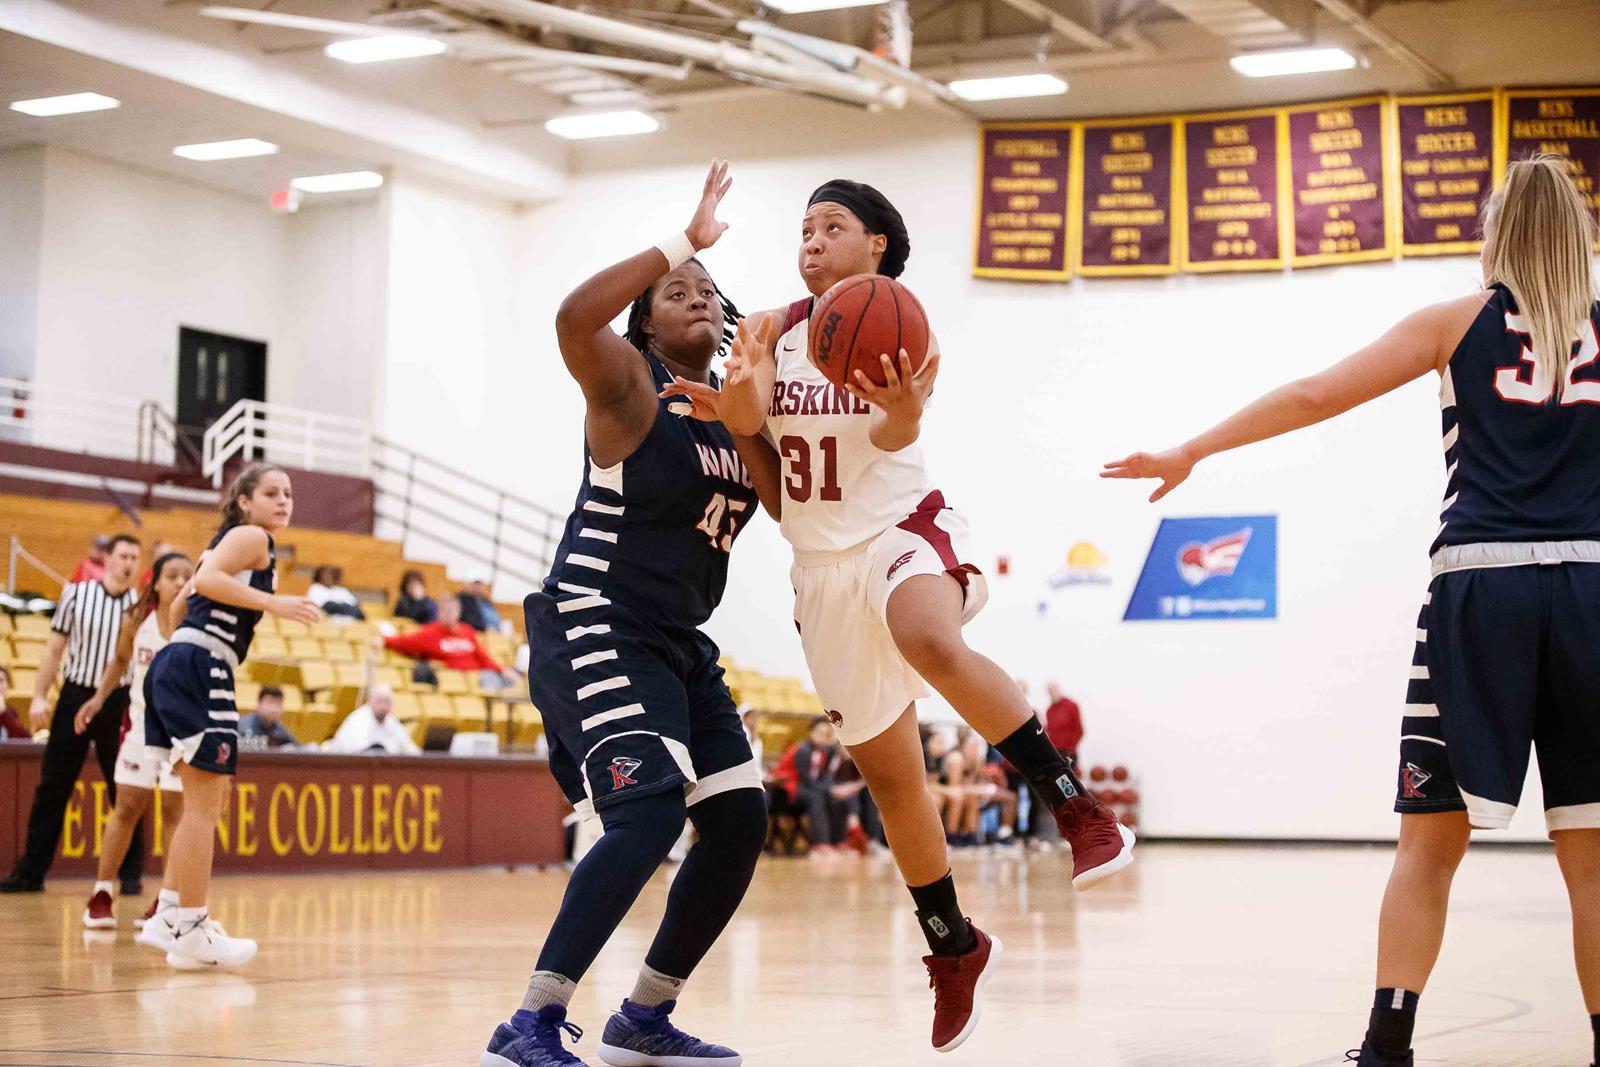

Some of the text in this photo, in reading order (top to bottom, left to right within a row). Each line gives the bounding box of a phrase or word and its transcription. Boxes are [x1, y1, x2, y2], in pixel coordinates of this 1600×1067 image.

[1493, 308, 1600, 406] 32
[780, 435, 842, 503] 31
[696, 492, 748, 553] 45
[268, 782, 443, 856] COLLEGE
